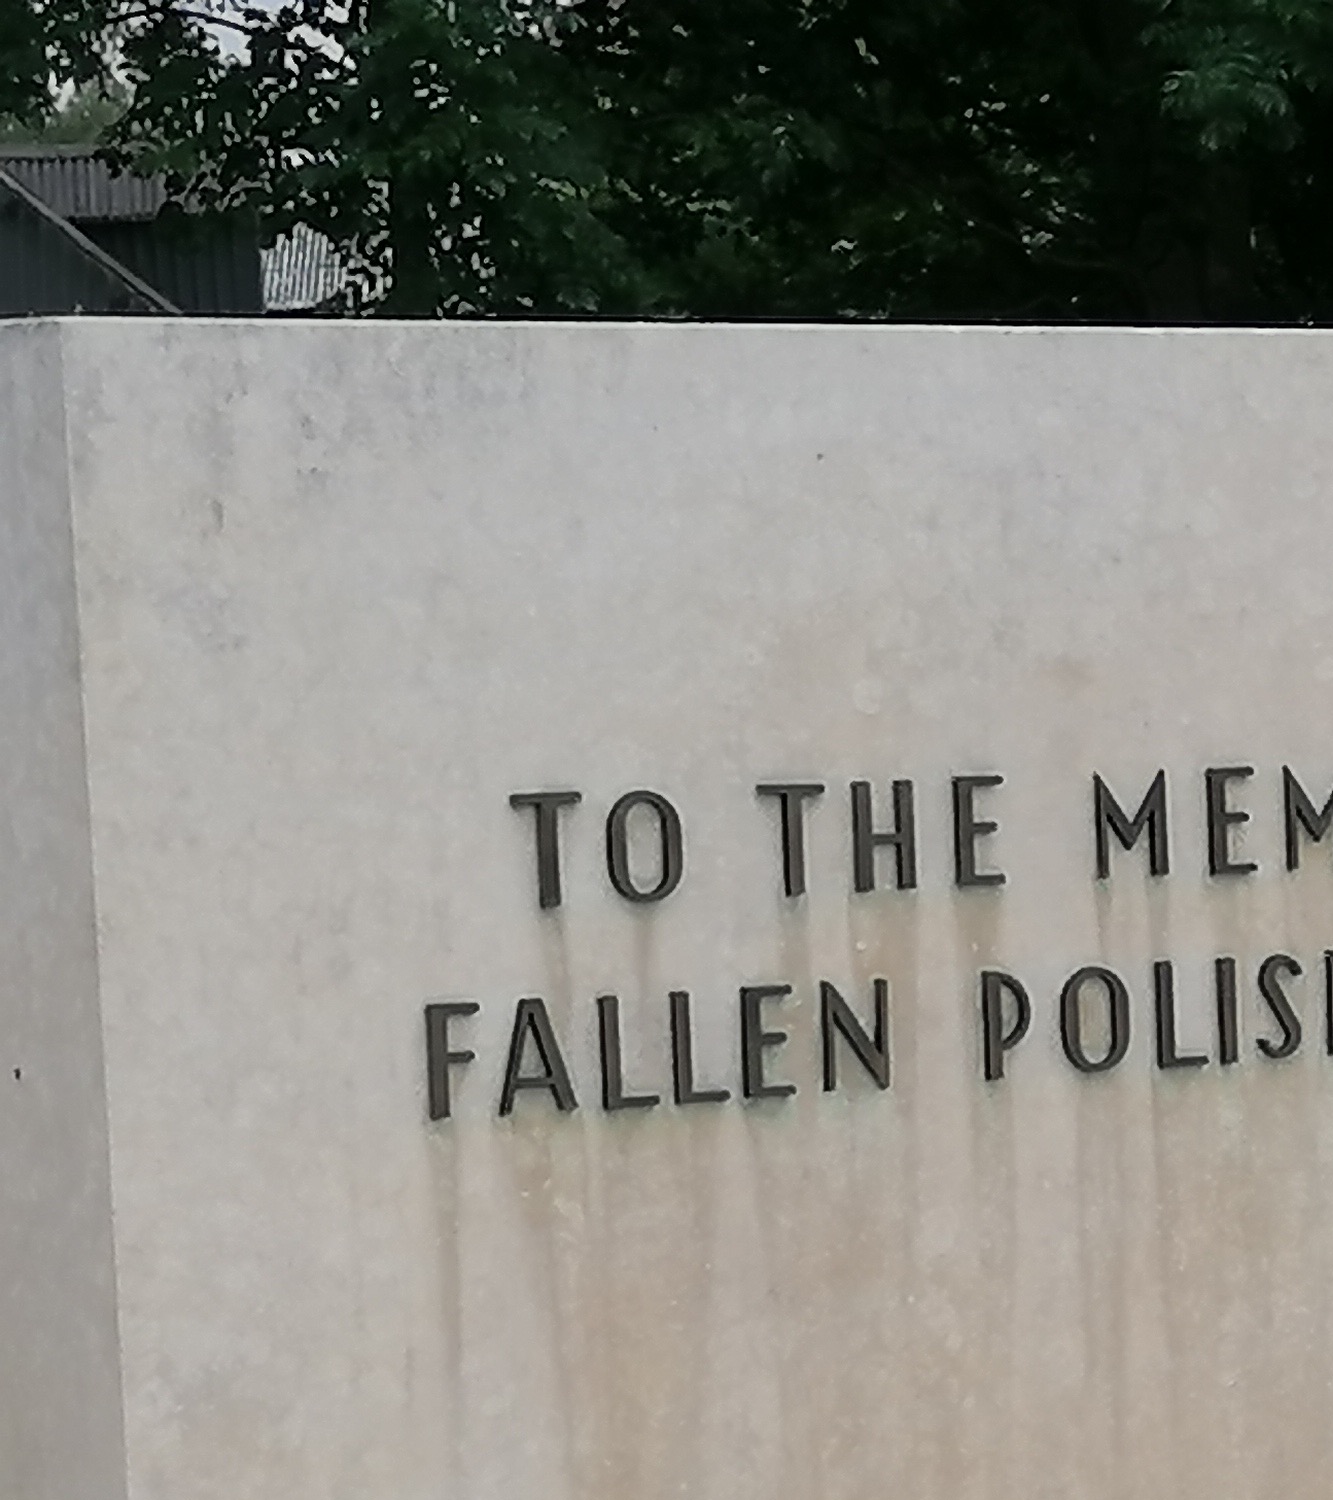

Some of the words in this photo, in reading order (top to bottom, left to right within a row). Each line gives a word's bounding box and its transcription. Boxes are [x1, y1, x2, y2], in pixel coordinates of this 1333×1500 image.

[509, 791, 682, 912] TO
[756, 775, 1006, 899] THE
[424, 978, 890, 1121] FALLEN
